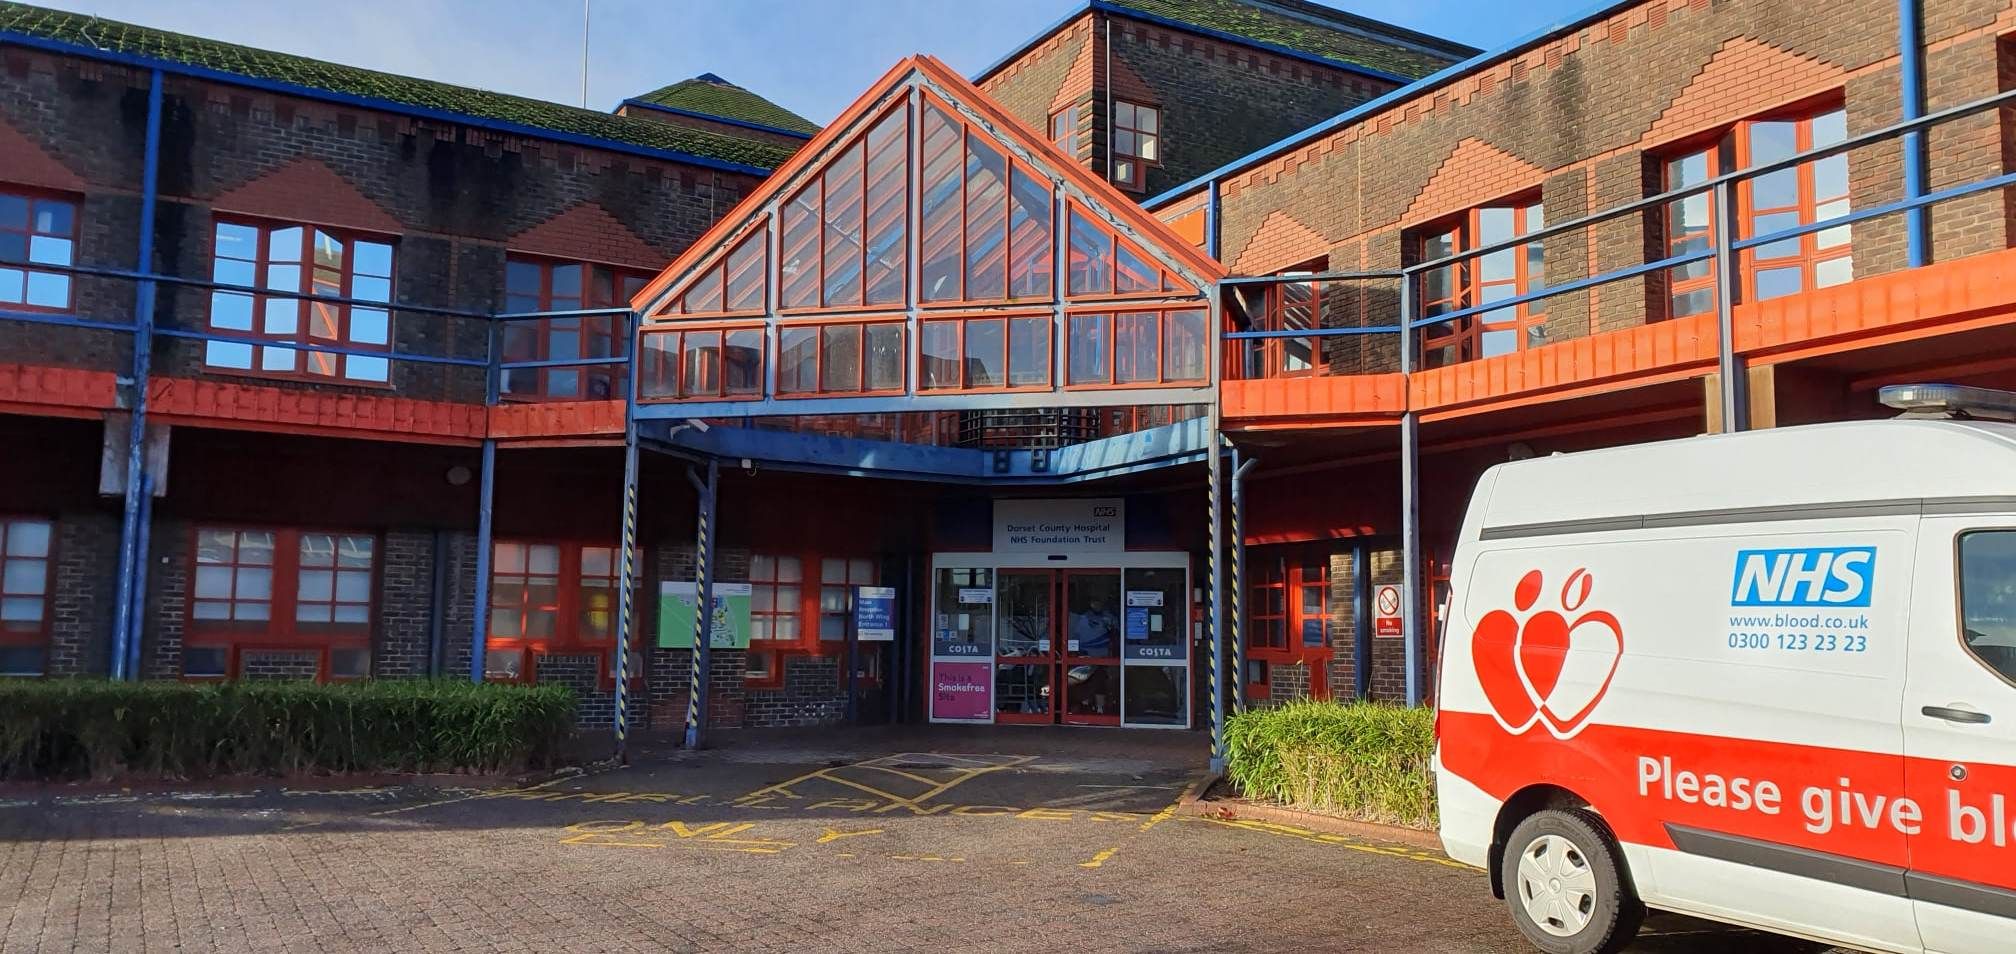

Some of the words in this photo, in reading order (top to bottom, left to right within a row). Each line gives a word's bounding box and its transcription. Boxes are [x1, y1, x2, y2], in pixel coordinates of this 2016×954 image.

[1095, 507, 1116, 517] NHS
[1007, 524, 1036, 533] Dorset
[1039, 524, 1071, 535] County
[1074, 524, 1110, 535] Hospital
[1010, 536, 1028, 544] NHS
[1031, 535, 1080, 544] Foundation
[1084, 536, 1106, 544] Trust
[1734, 551, 1872, 603] NHS
[1730, 614, 1868, 629] www.blood.co.uk
[1728, 633, 1770, 649] 0300
[1777, 634, 1808, 650] 123
[1814, 634, 1837, 651] 23
[1844, 635, 1867, 652] 23
[948, 645, 979, 654] COSTA
[1139, 647, 1172, 656] COSTA
[938, 683, 985, 692] Smokefree
[1637, 755, 1783, 816] Please
[1800, 777, 1923, 835] give
[1947, 788, 2016, 848] bl
[564, 819, 885, 847] ONLY
